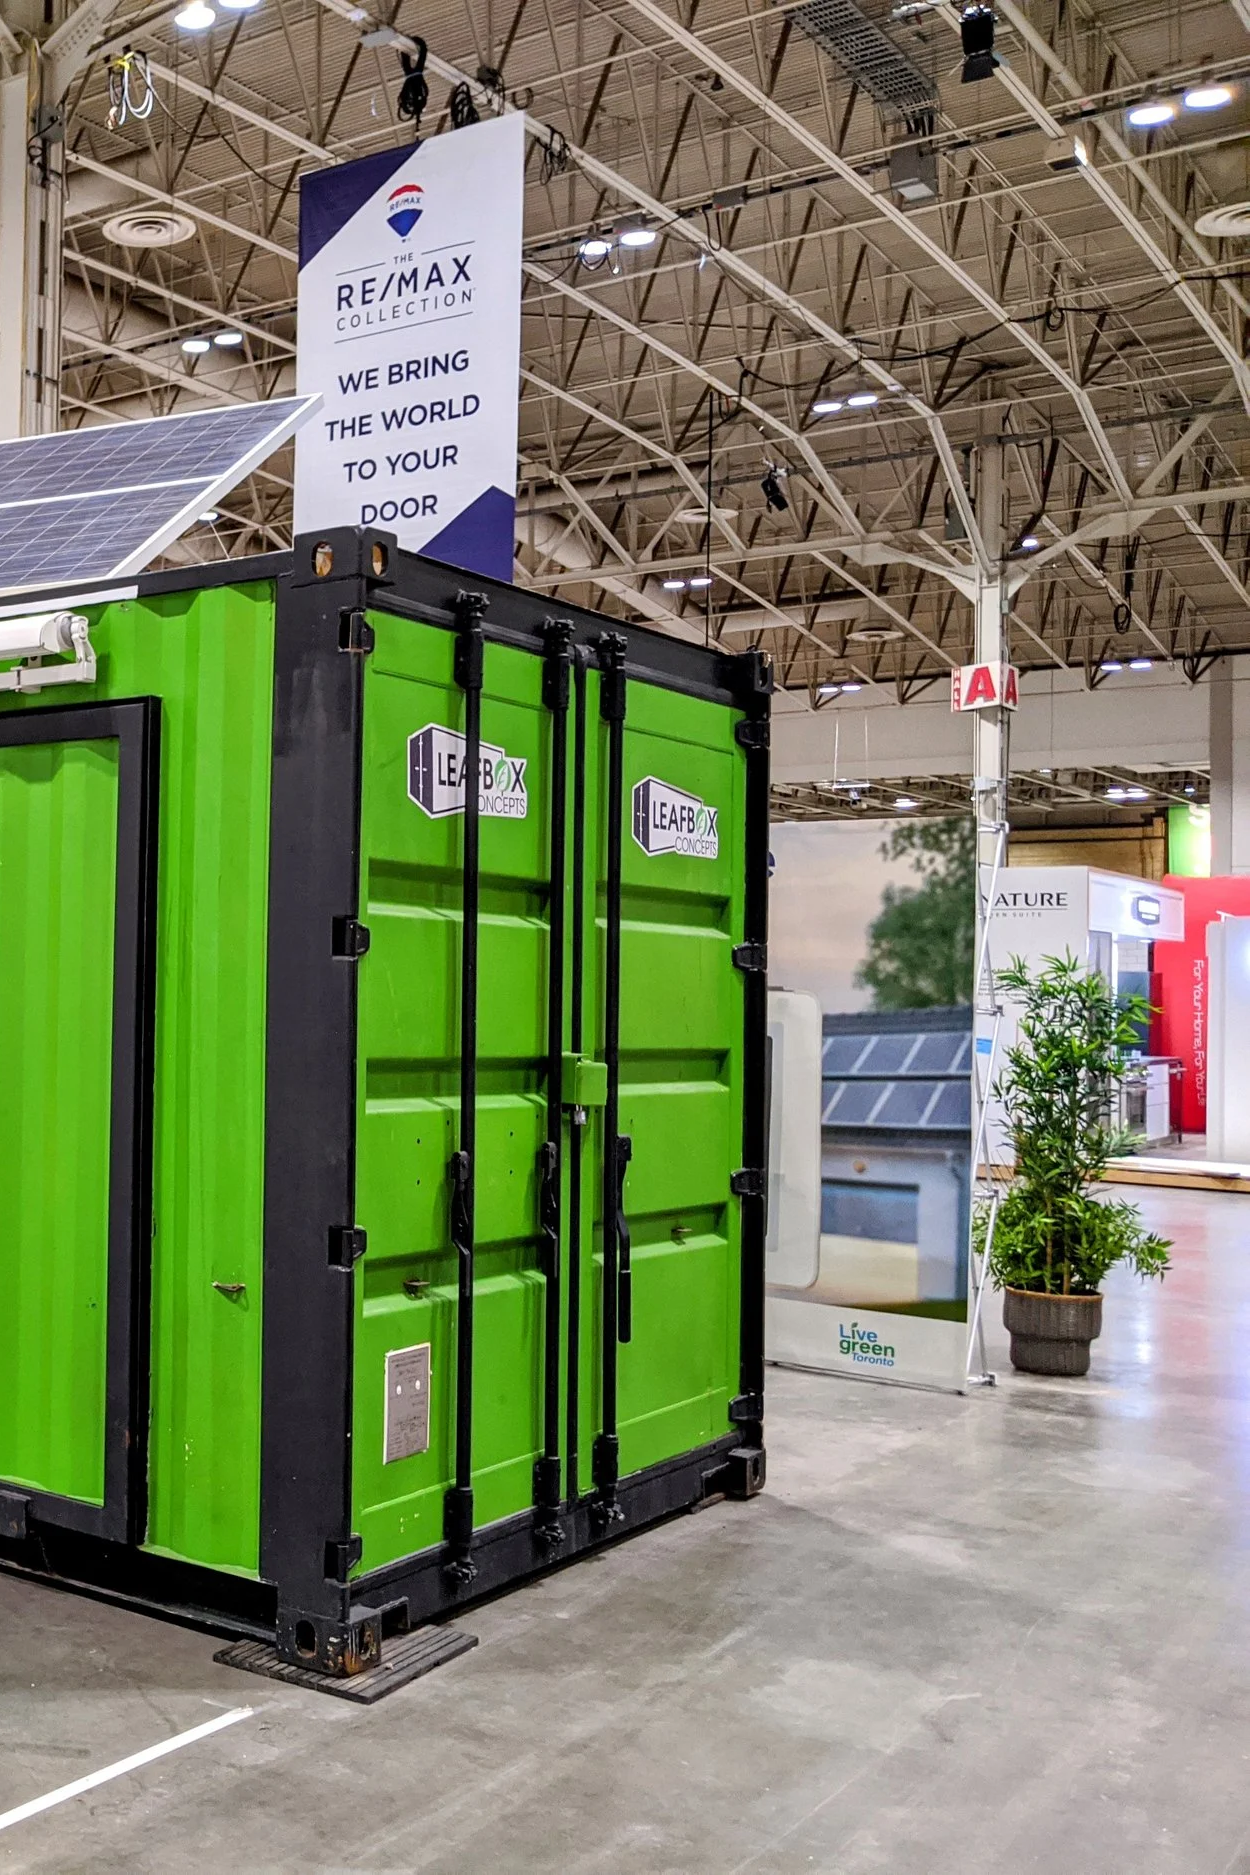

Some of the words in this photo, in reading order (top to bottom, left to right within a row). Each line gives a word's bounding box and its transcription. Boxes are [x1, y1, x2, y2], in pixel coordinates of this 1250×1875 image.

[393, 252, 414, 265] THE
[337, 254, 472, 312] RE/MAX
[336, 288, 473, 332] COLLECTION
[338, 367, 380, 396] WE
[388, 349, 470, 386] BRING
[325, 413, 373, 442] THE
[381, 394, 480, 432] WORLD
[343, 458, 377, 483] TO
[385, 444, 458, 476] YOUR
[361, 494, 438, 525] DOOR
[953, 669, 961, 711] HALL
[964, 665, 997, 706] A
[1004, 667, 1018, 706] A
[479, 794, 526, 816] ONCEPTS
[653, 800, 718, 837] LEAFBOX
[675, 836, 717, 857] CONCEPTS
[1012, 911, 1042, 921] SUITE
[1194, 959, 1204, 981] For
[1193, 982, 1204, 1011] Your
[1193, 1011, 1204, 1050] Home,
[1194, 1050, 1205, 1070] For
[839, 1322, 878, 1343] Live
[840, 1339, 895, 1358] green
[852, 1352, 895, 1367] Toronto
